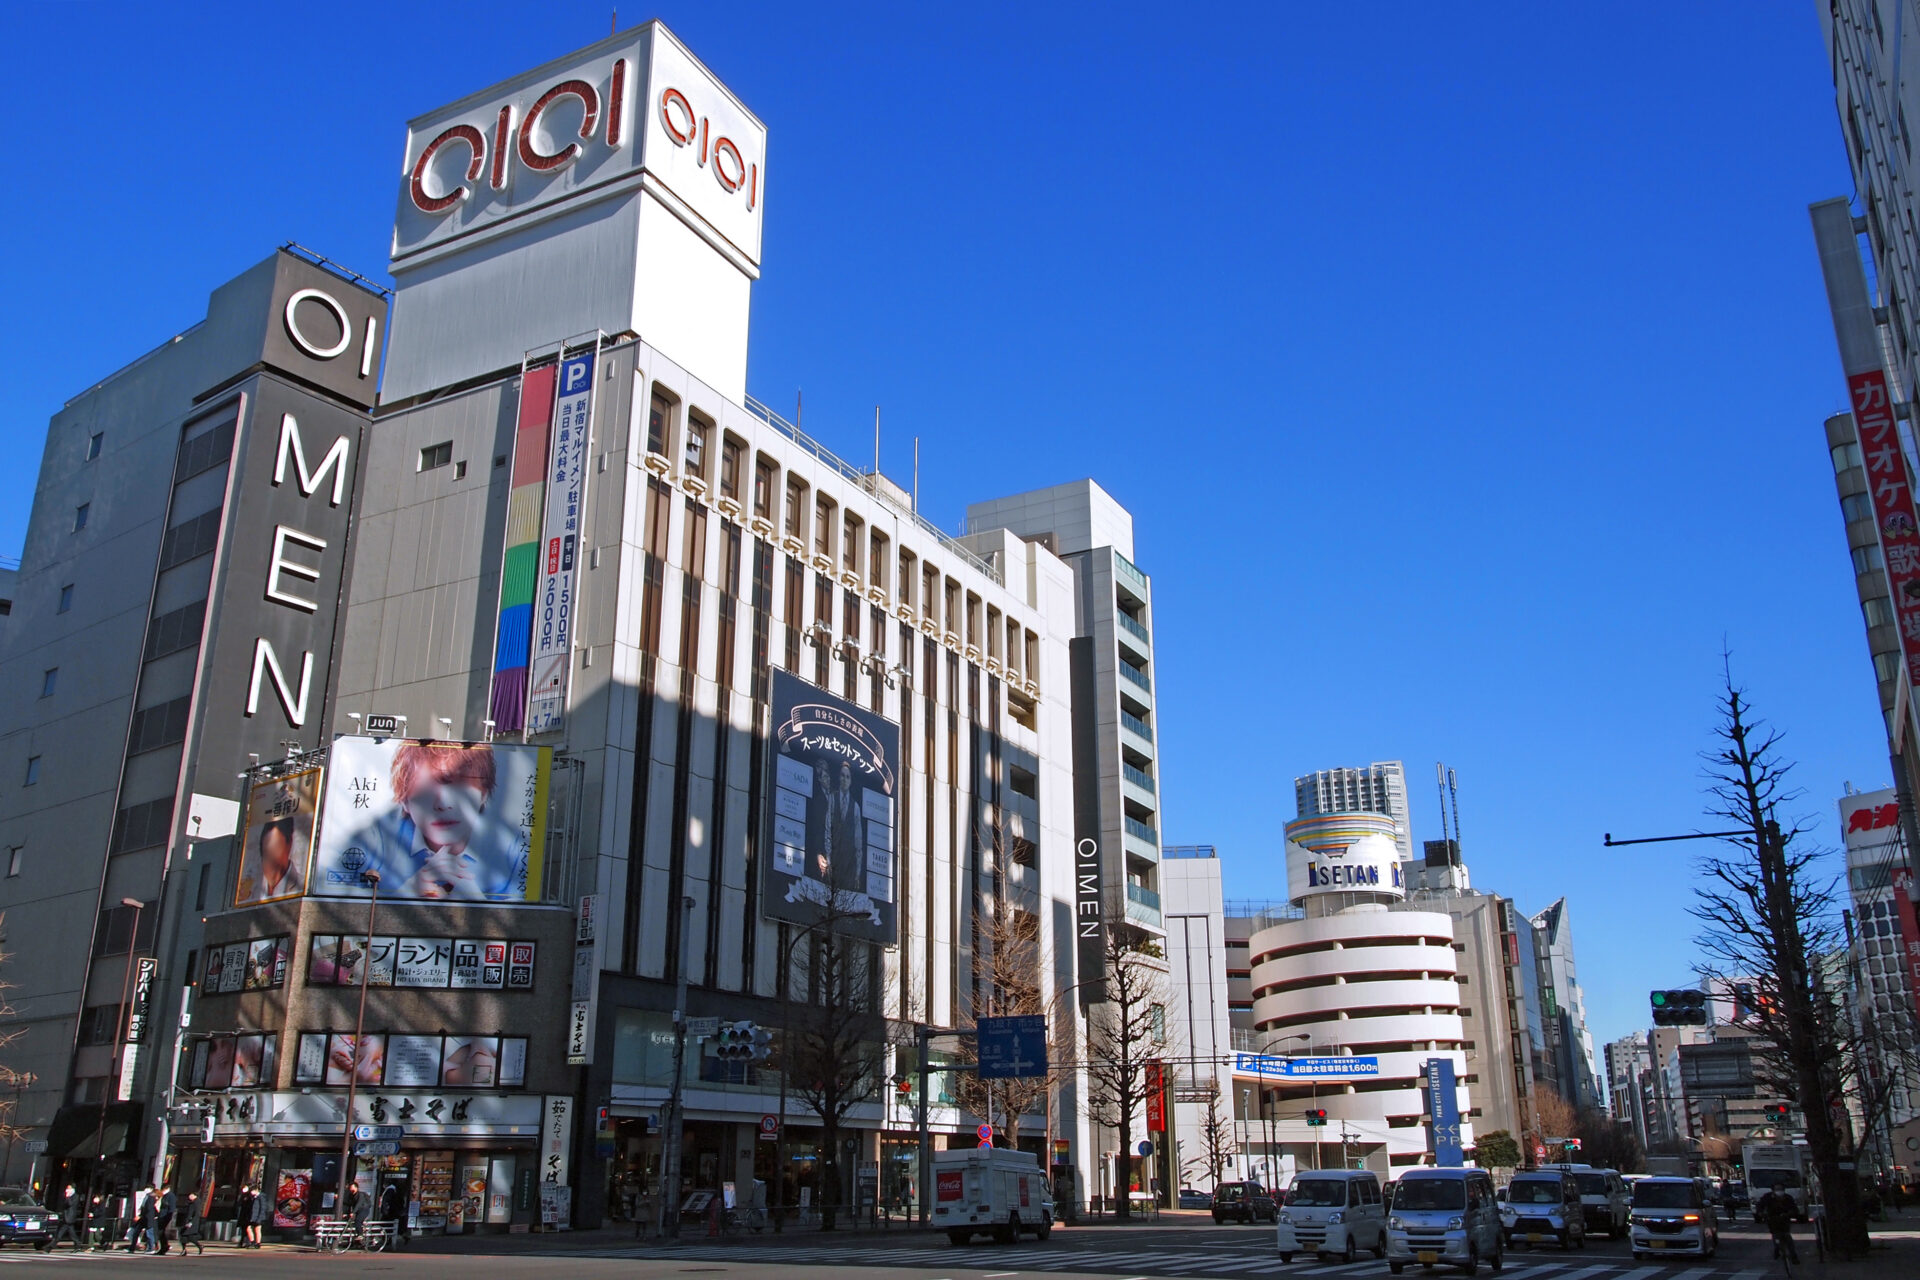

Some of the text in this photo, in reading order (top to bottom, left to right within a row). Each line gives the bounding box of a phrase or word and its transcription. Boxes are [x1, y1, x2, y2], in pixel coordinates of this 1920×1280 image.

[566, 362, 586, 392] P
[556, 403, 572, 483] 当日最大料金
[1855, 380, 1907, 509] カラオケ
[565, 398, 587, 531] 新宿マルイメン駐車場
[541, 577, 556, 651] 2000円
[556, 574, 569, 648] 1500円
[370, 718, 394, 729] JUN
[800, 735, 875, 773] スーツ&セットアップ
[348, 776, 377, 792] Aki
[352, 793, 370, 809] 秋
[1307, 861, 1380, 888] ISETAN
[225, 951, 244, 968] 買取
[371, 942, 478, 968] ブランド品
[487, 946, 530, 963] 買取
[484, 967, 529, 984] 販売
[370, 1097, 473, 1123] 富士そば
[552, 1100, 566, 1138] 茹でたて
[1437, 1135, 1447, 1145] P
[1450, 1135, 1460, 1145] P
[545, 1153, 562, 1184] そば
